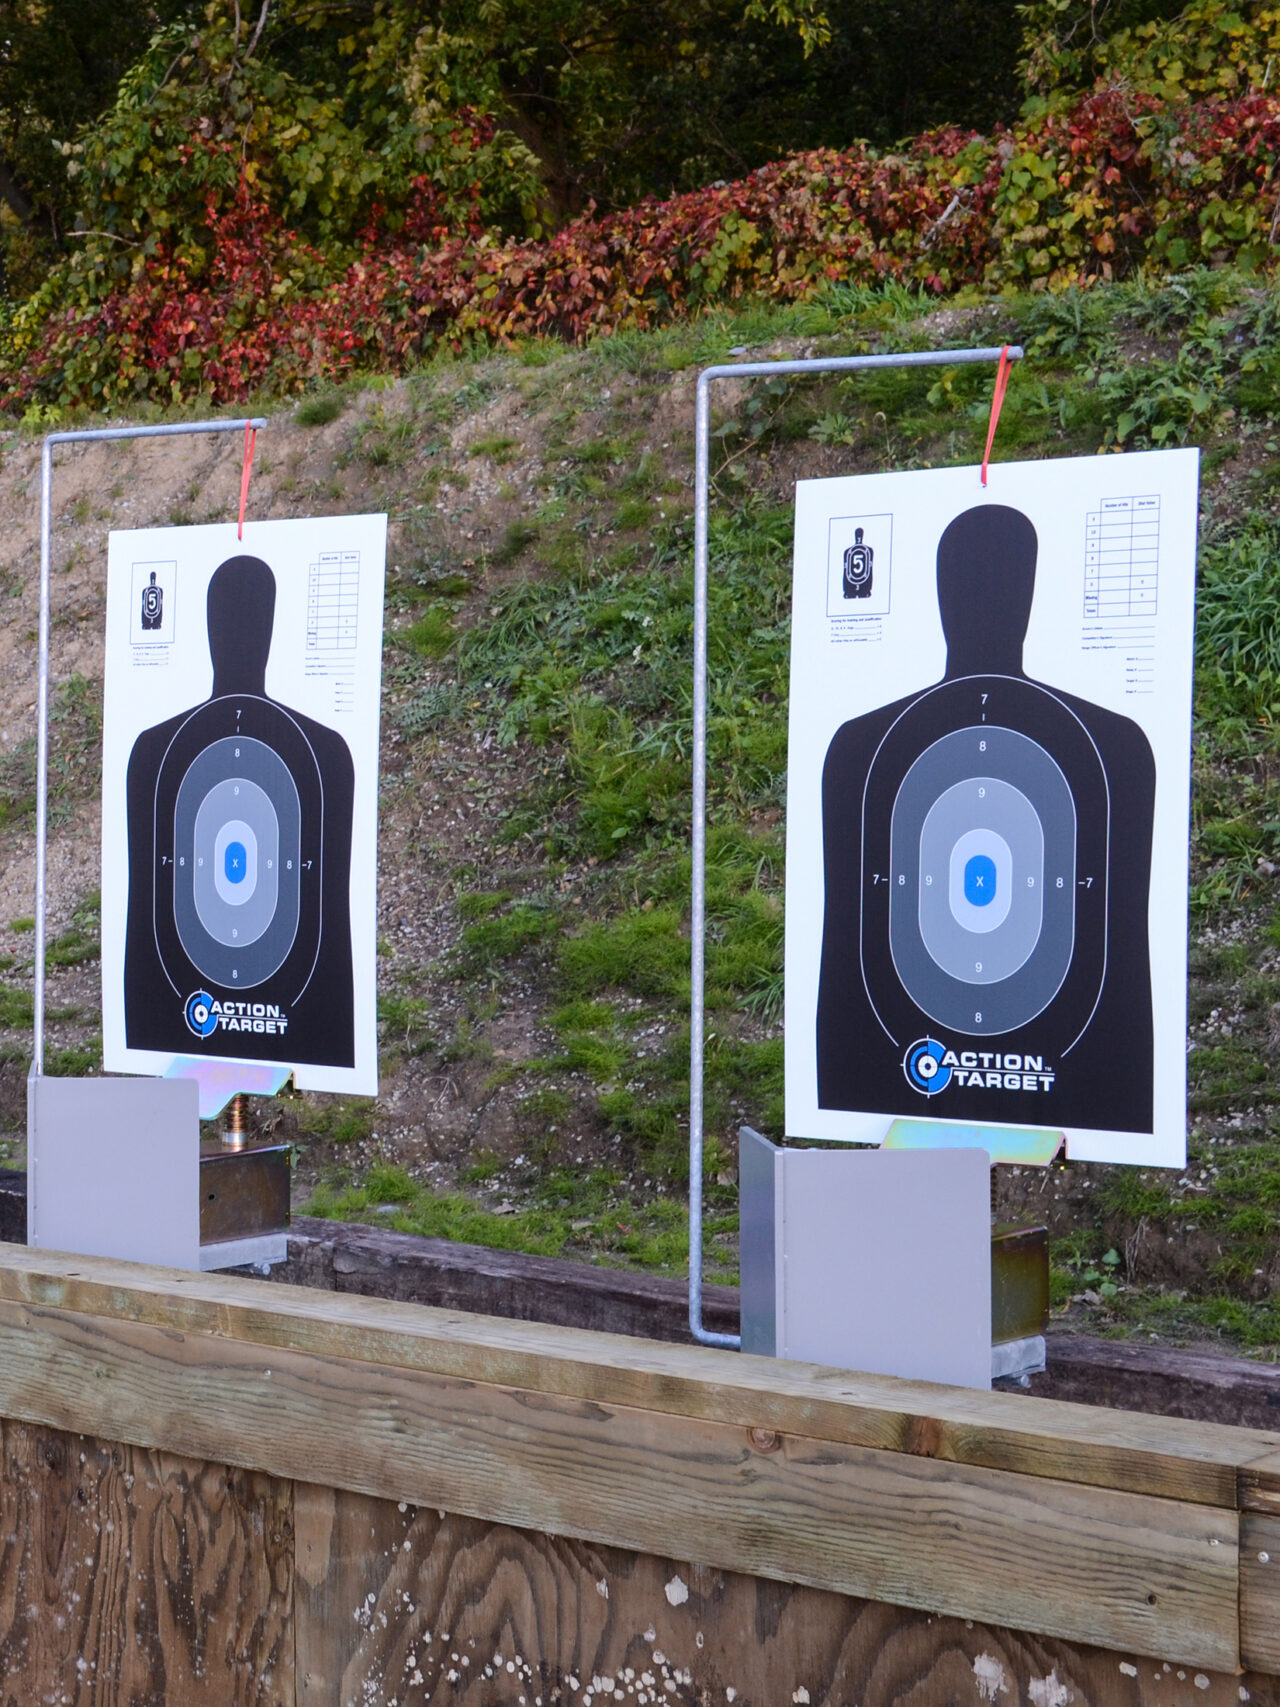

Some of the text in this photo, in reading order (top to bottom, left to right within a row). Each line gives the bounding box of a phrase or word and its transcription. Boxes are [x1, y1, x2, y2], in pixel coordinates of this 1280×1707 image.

[853, 554, 864, 574] 5
[148, 593, 157, 610] 5
[981, 693, 988, 705] 7
[236, 709, 242, 719] 7
[978, 740, 987, 752] 8
[234, 748, 241, 758] 8
[233, 785, 240, 796] 9
[978, 787, 986, 799] 9
[179, 856, 185, 866] 8
[197, 857, 204, 867] 9
[232, 858, 239, 868] X
[267, 859, 273, 869] 9
[286, 859, 293, 870] 8
[898, 874, 906, 886] 8
[925, 875, 933, 886] 9
[976, 876, 984, 887] X
[1027, 876, 1035, 888] 9
[1055, 877, 1064, 889] 8
[232, 928, 238, 938] 9
[975, 961, 983, 973] 9
[232, 969, 238, 979] 8
[210, 1001, 280, 1018] ACTION
[974, 1011, 983, 1023] 8
[219, 1018, 288, 1035] TARGET
[942, 1051, 1043, 1071] ACTION
[953, 1071, 1055, 1092] TARGET
